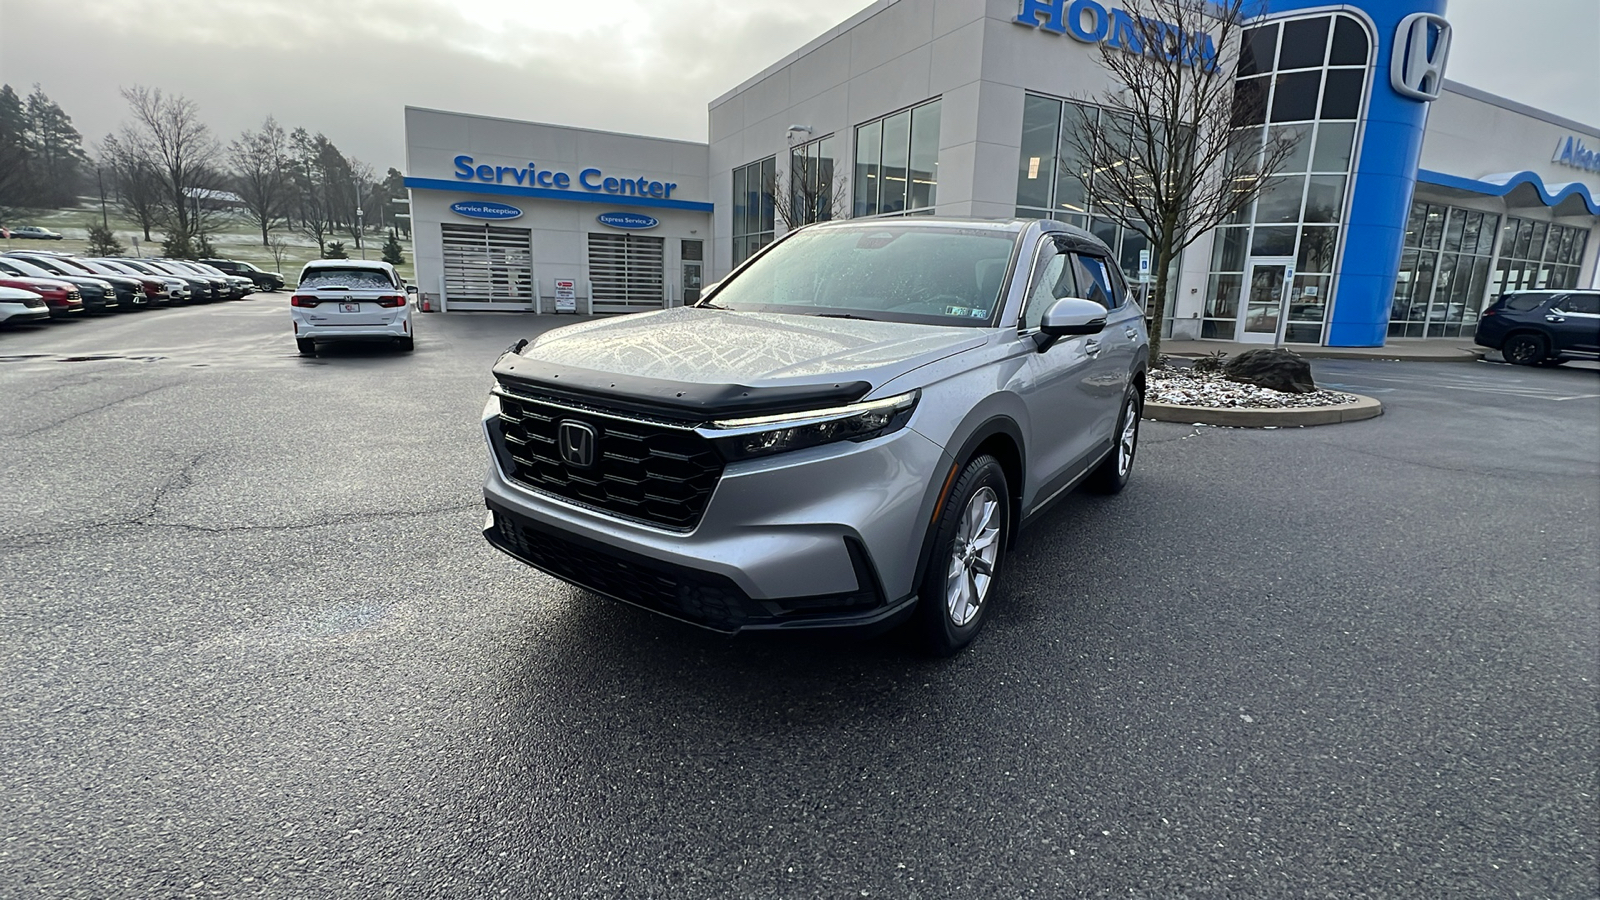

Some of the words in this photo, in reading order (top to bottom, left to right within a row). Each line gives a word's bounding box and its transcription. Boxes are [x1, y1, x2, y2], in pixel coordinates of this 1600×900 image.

[1013, 0, 1221, 74] HONDA
[454, 155, 570, 188] Service
[579, 168, 677, 198] Center
[454, 204, 482, 212] Service
[482, 206, 519, 215] Reception
[600, 215, 624, 223] Express
[624, 217, 647, 225] Service
